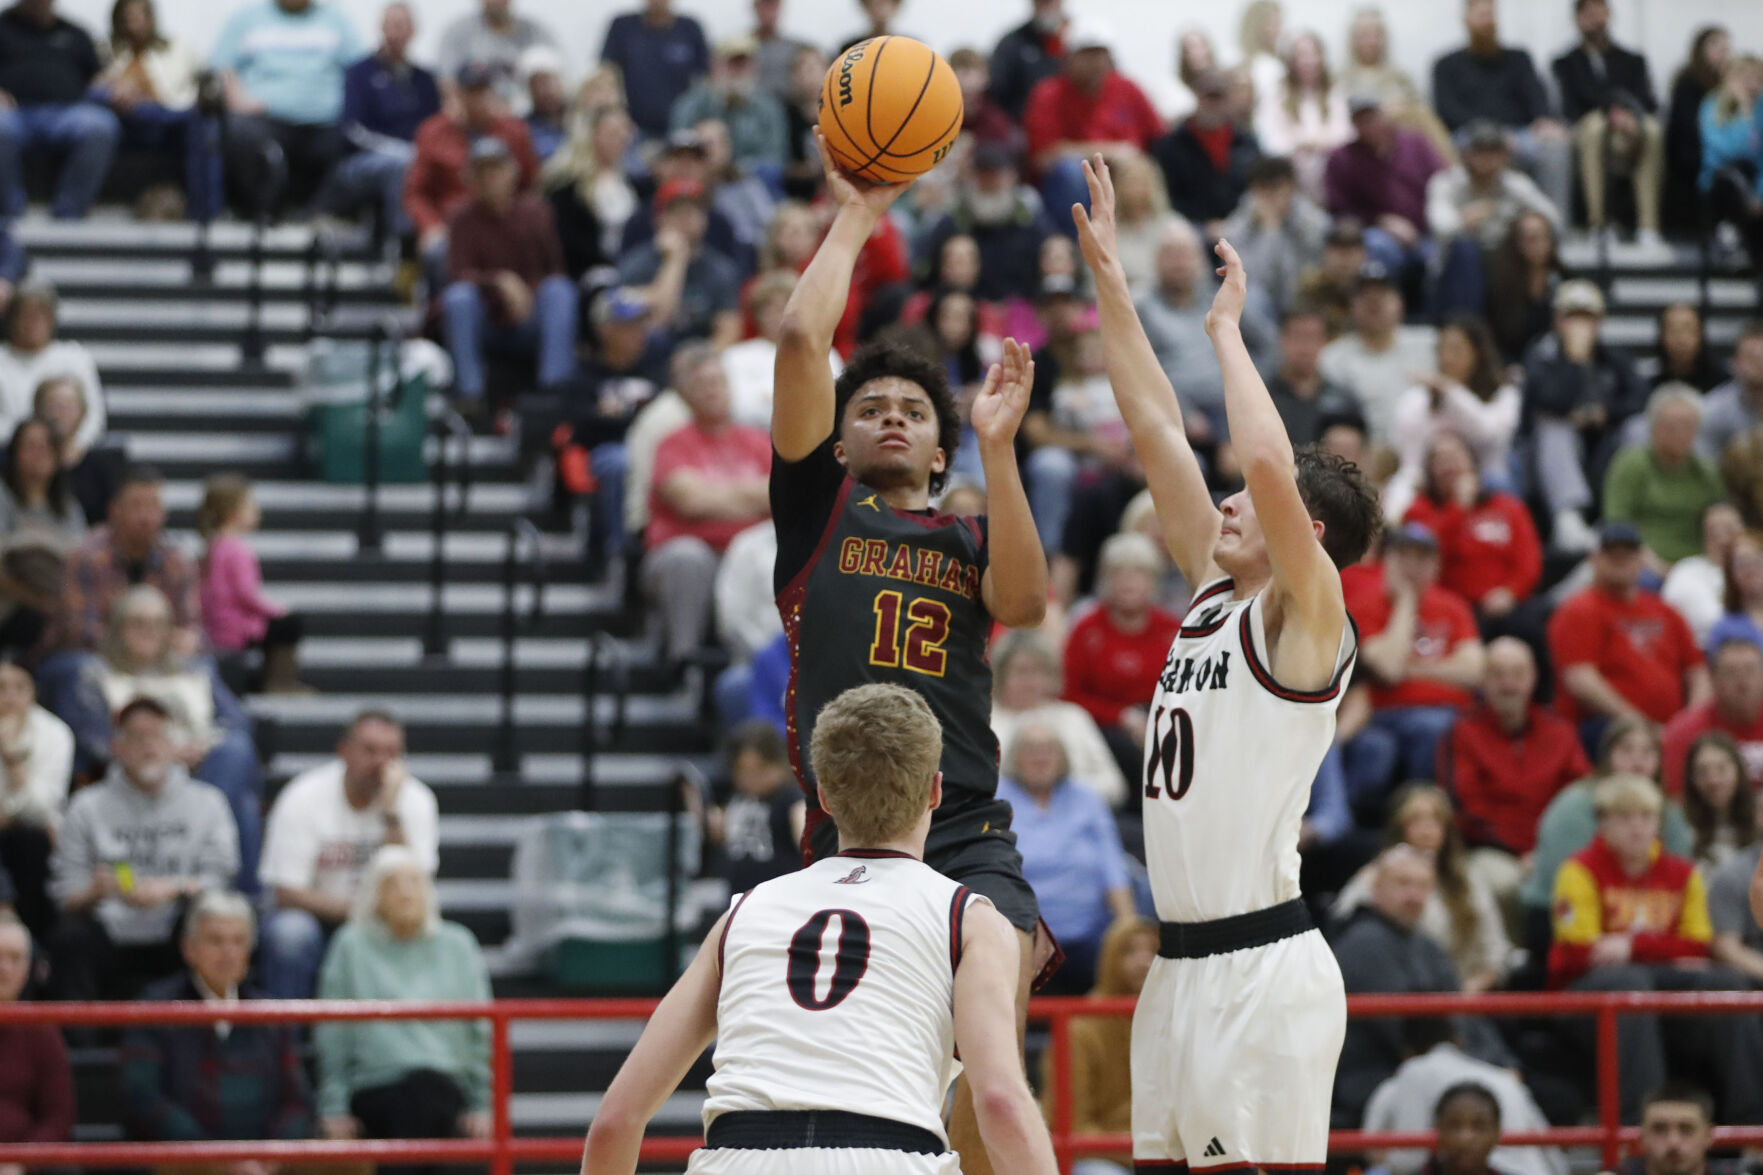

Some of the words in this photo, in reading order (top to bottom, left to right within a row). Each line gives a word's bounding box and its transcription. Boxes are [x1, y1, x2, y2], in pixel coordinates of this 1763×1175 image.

[869, 589, 952, 677] 12
[1145, 704, 1195, 801] 10
[786, 908, 871, 1012] 0
